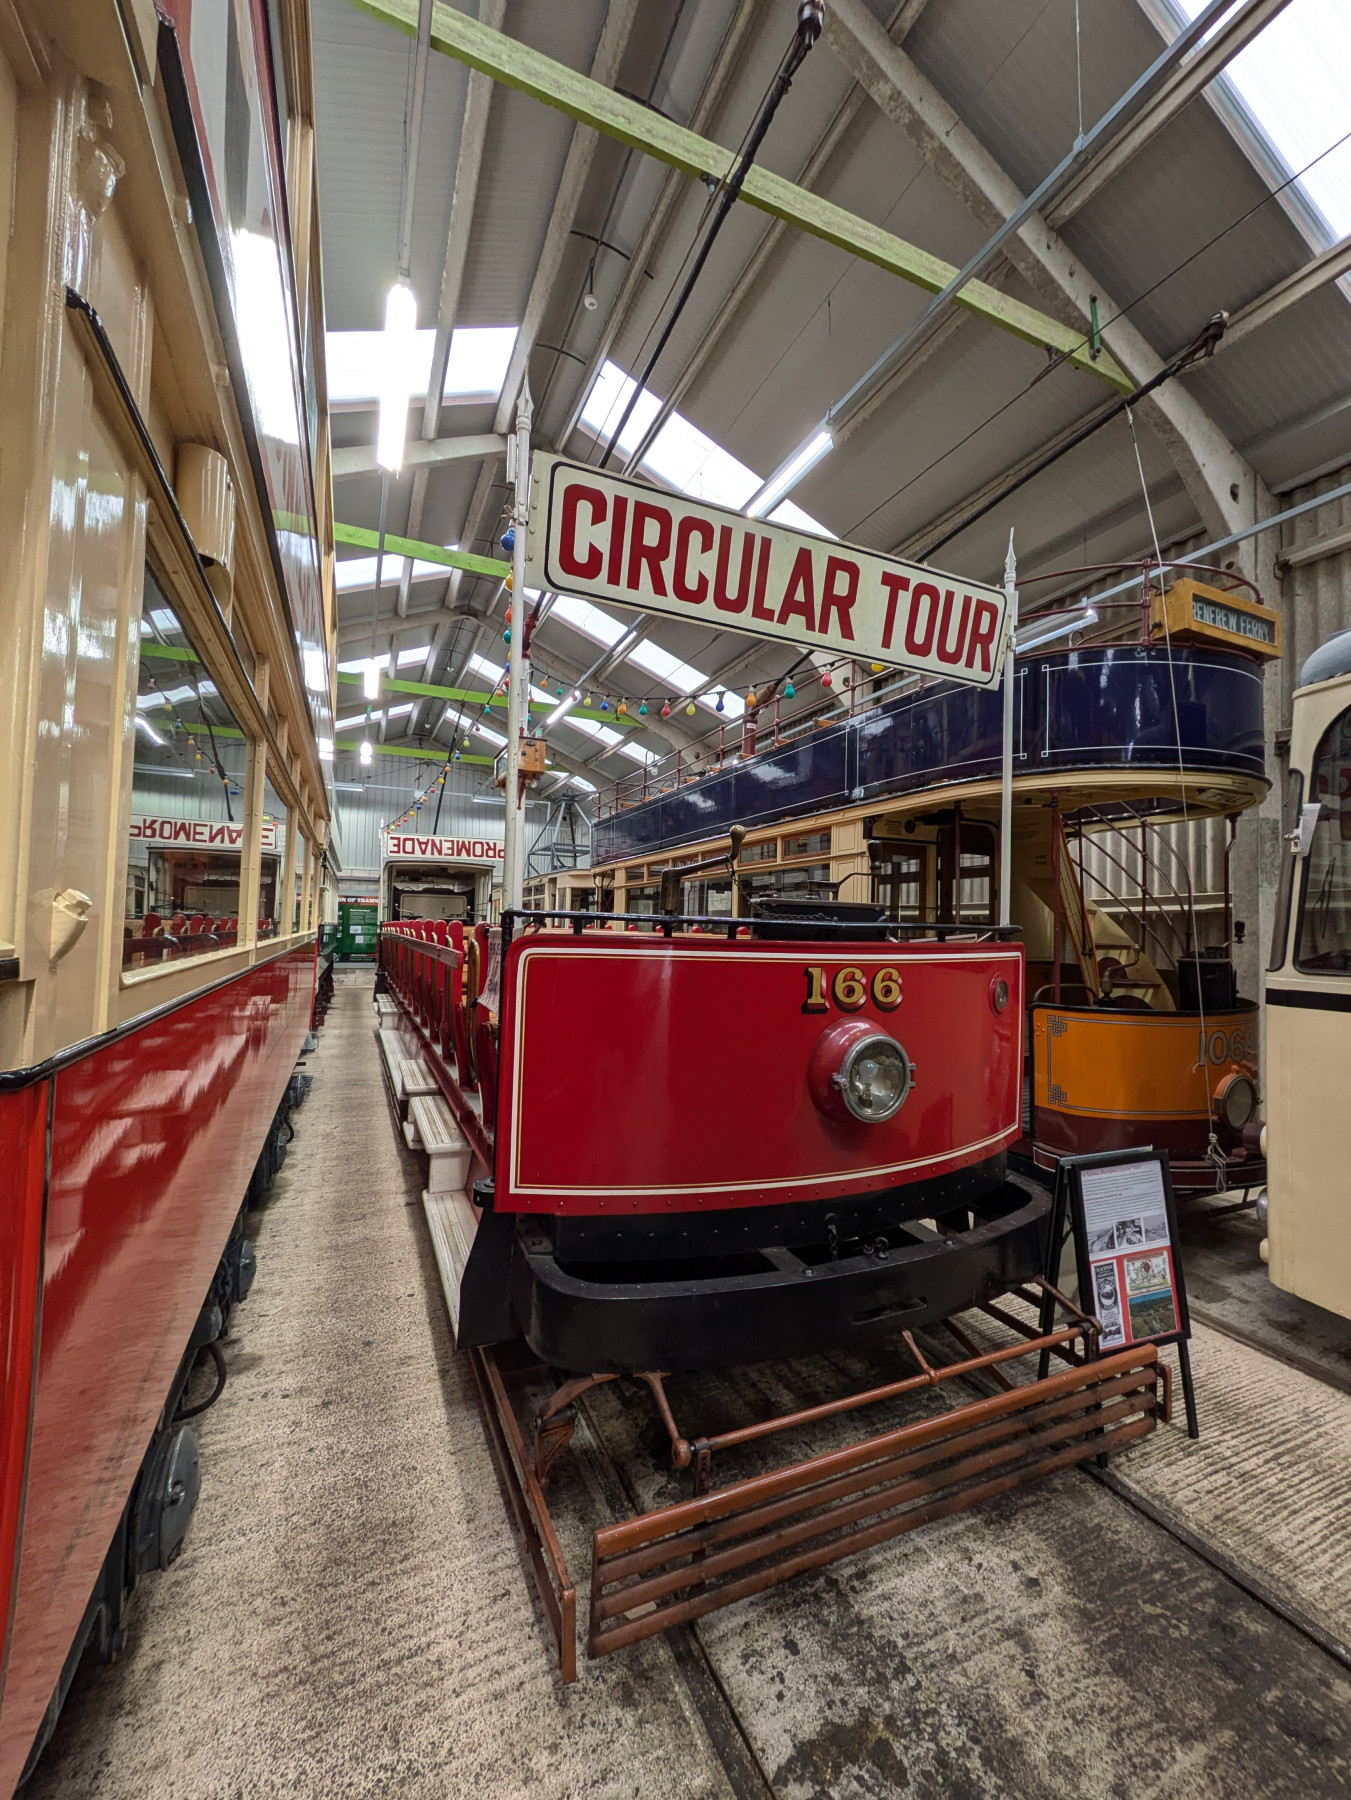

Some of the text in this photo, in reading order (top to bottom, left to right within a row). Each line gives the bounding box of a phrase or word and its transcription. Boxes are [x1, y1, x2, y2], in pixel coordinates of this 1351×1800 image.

[558, 483, 999, 673] CIRCULAR TOUR
[1240, 615, 1270, 643] FERRY
[801, 966, 903, 1014] 166
